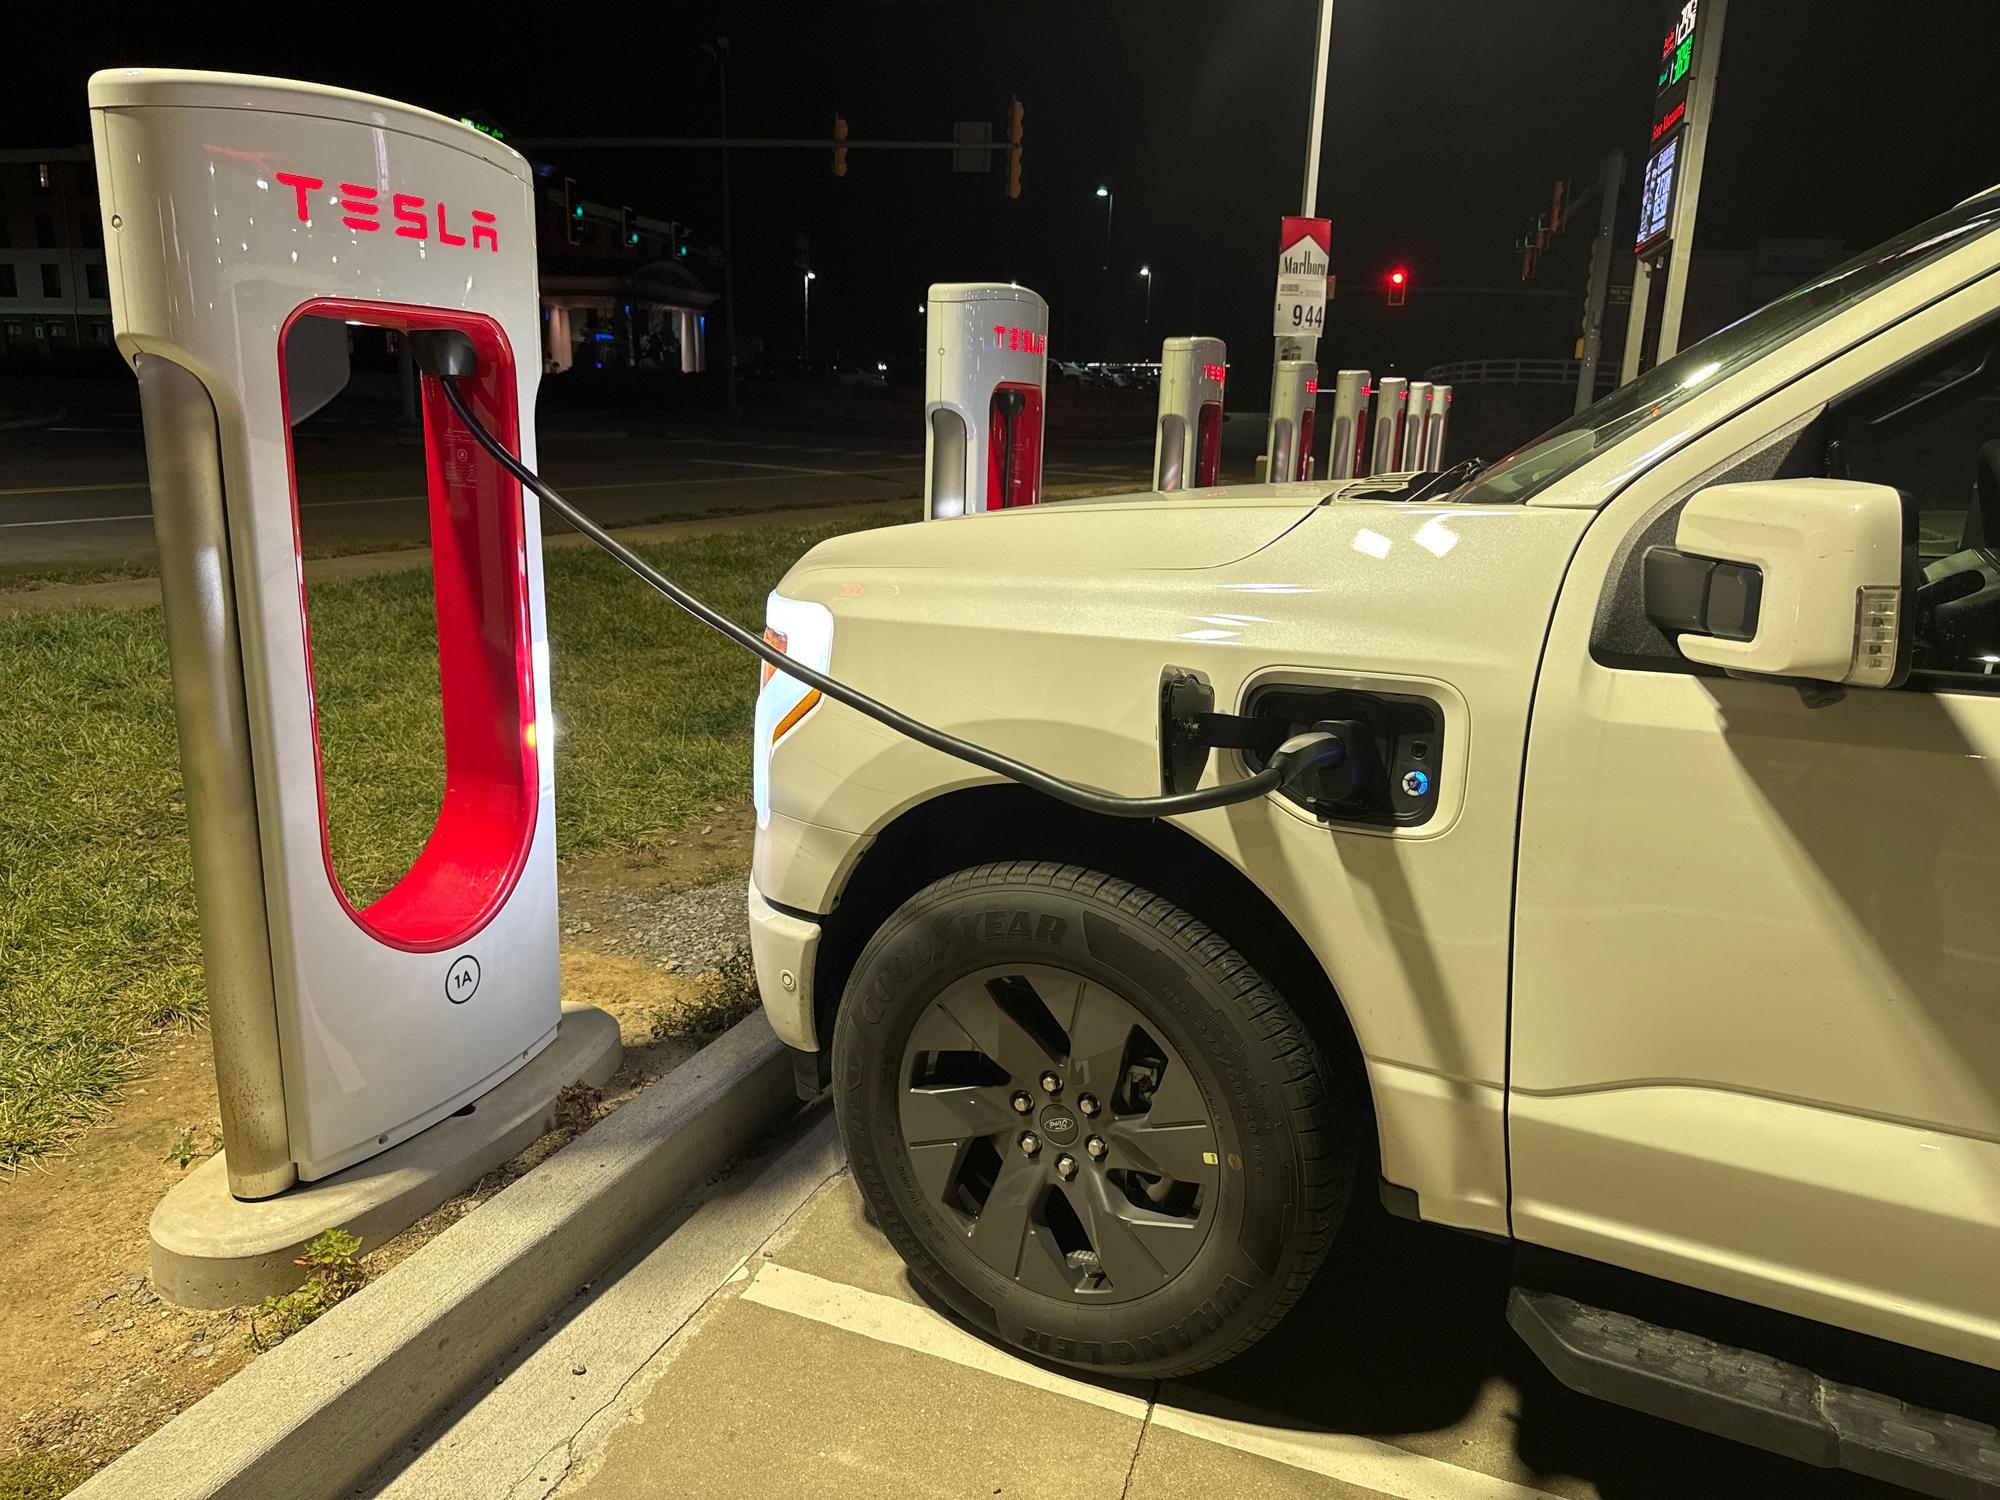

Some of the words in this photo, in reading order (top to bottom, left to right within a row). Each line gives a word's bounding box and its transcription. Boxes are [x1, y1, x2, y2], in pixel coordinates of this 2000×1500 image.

[276, 172, 498, 252] TESLA
[1283, 250, 1326, 276] Marlboro
[454, 970, 472, 989] 1A
